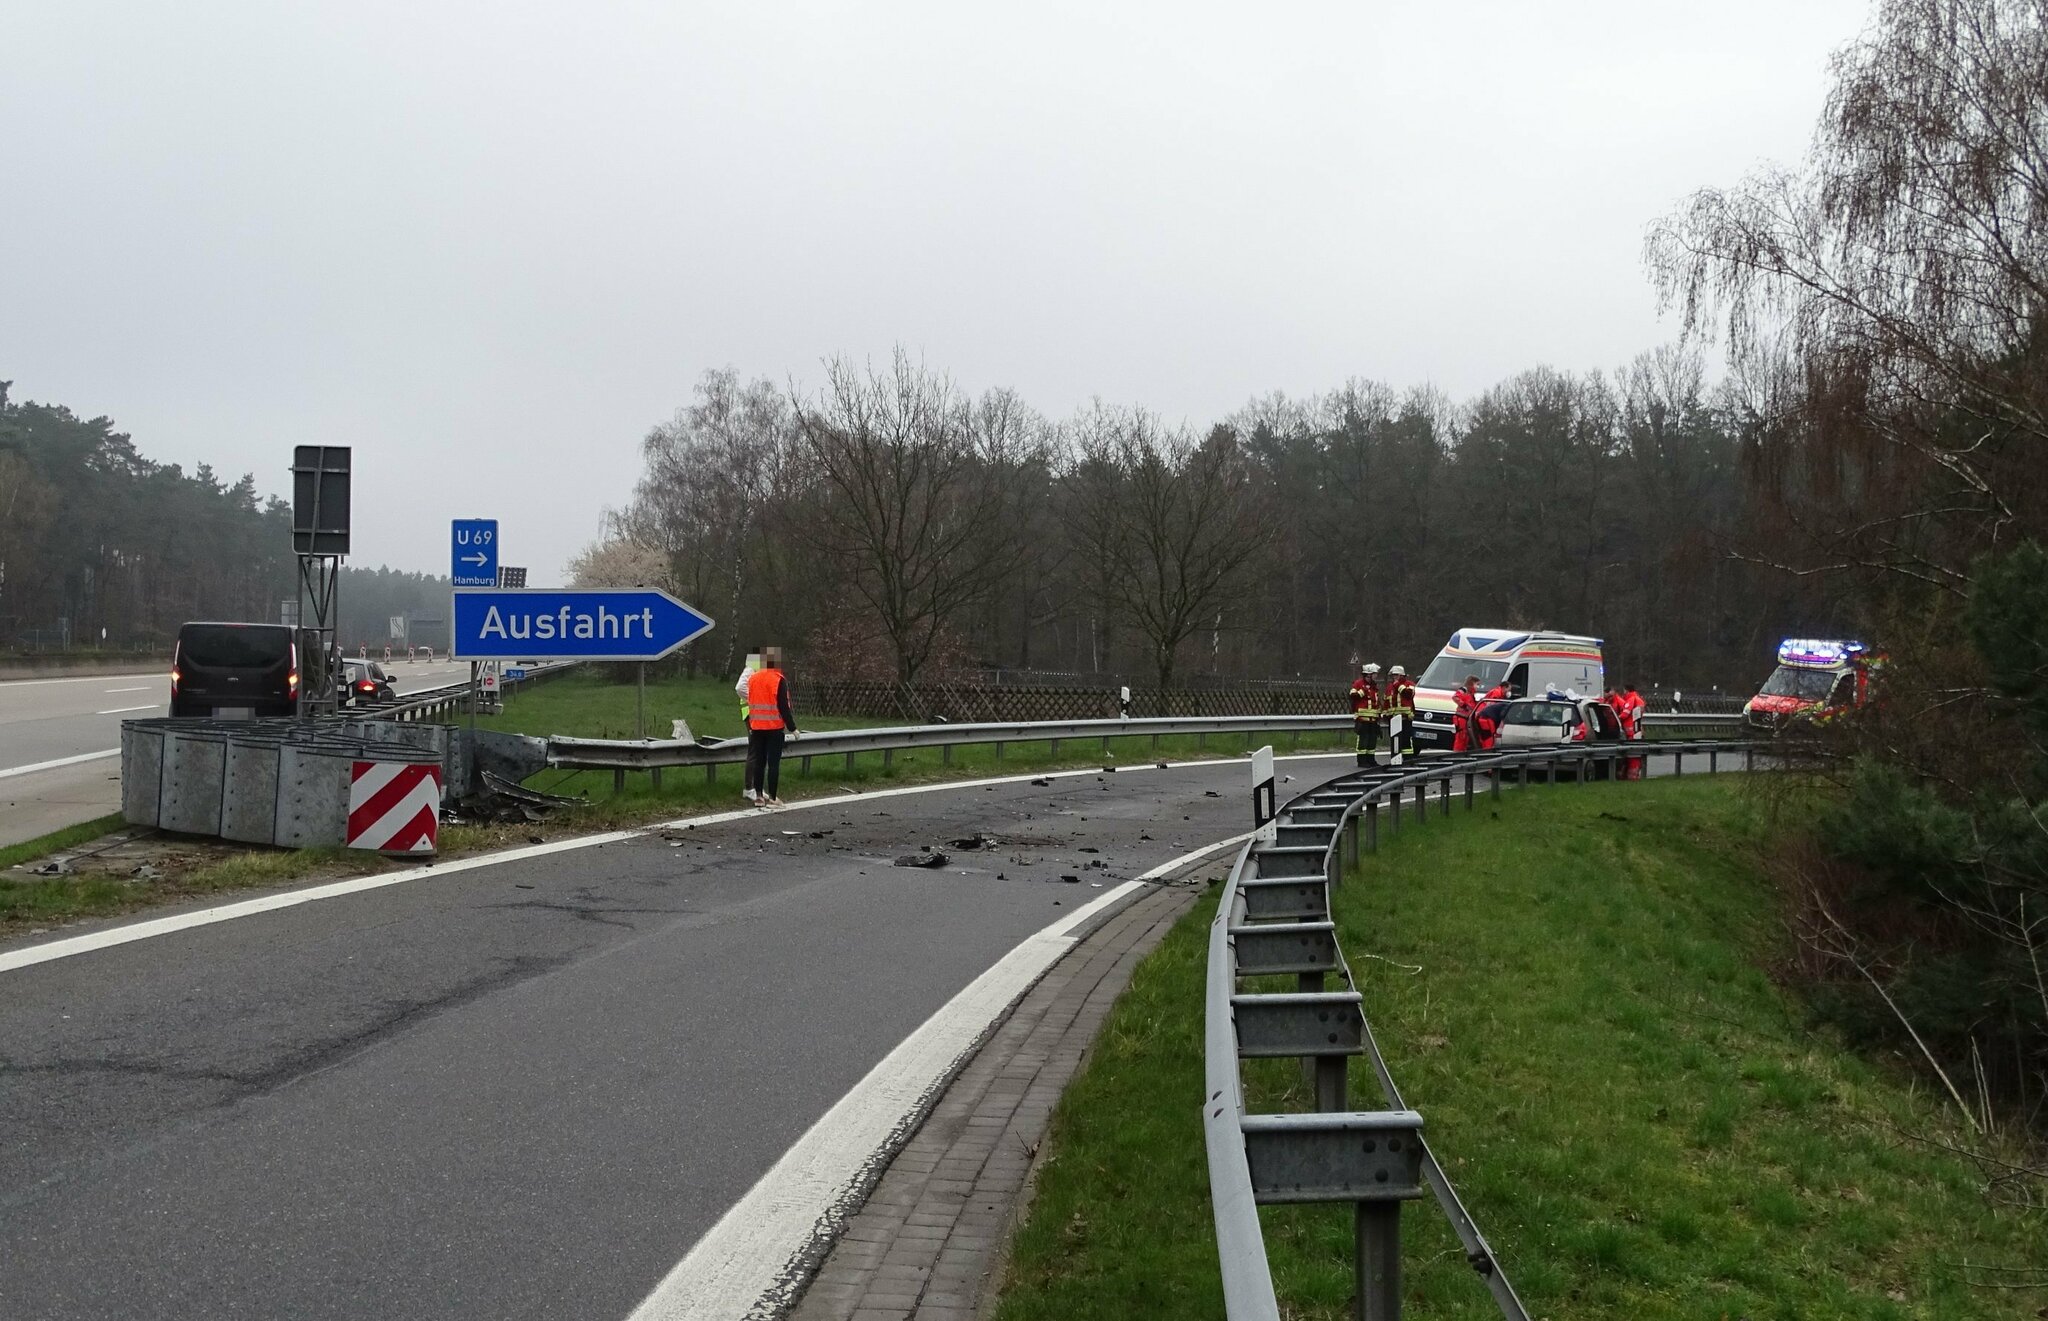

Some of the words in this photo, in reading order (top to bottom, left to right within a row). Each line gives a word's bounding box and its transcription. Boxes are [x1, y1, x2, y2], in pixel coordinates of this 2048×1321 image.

[457, 530, 469, 545] U
[473, 530, 493, 545] 69
[454, 576, 495, 587] Hamburg
[479, 605, 653, 639] Ausfahrt
